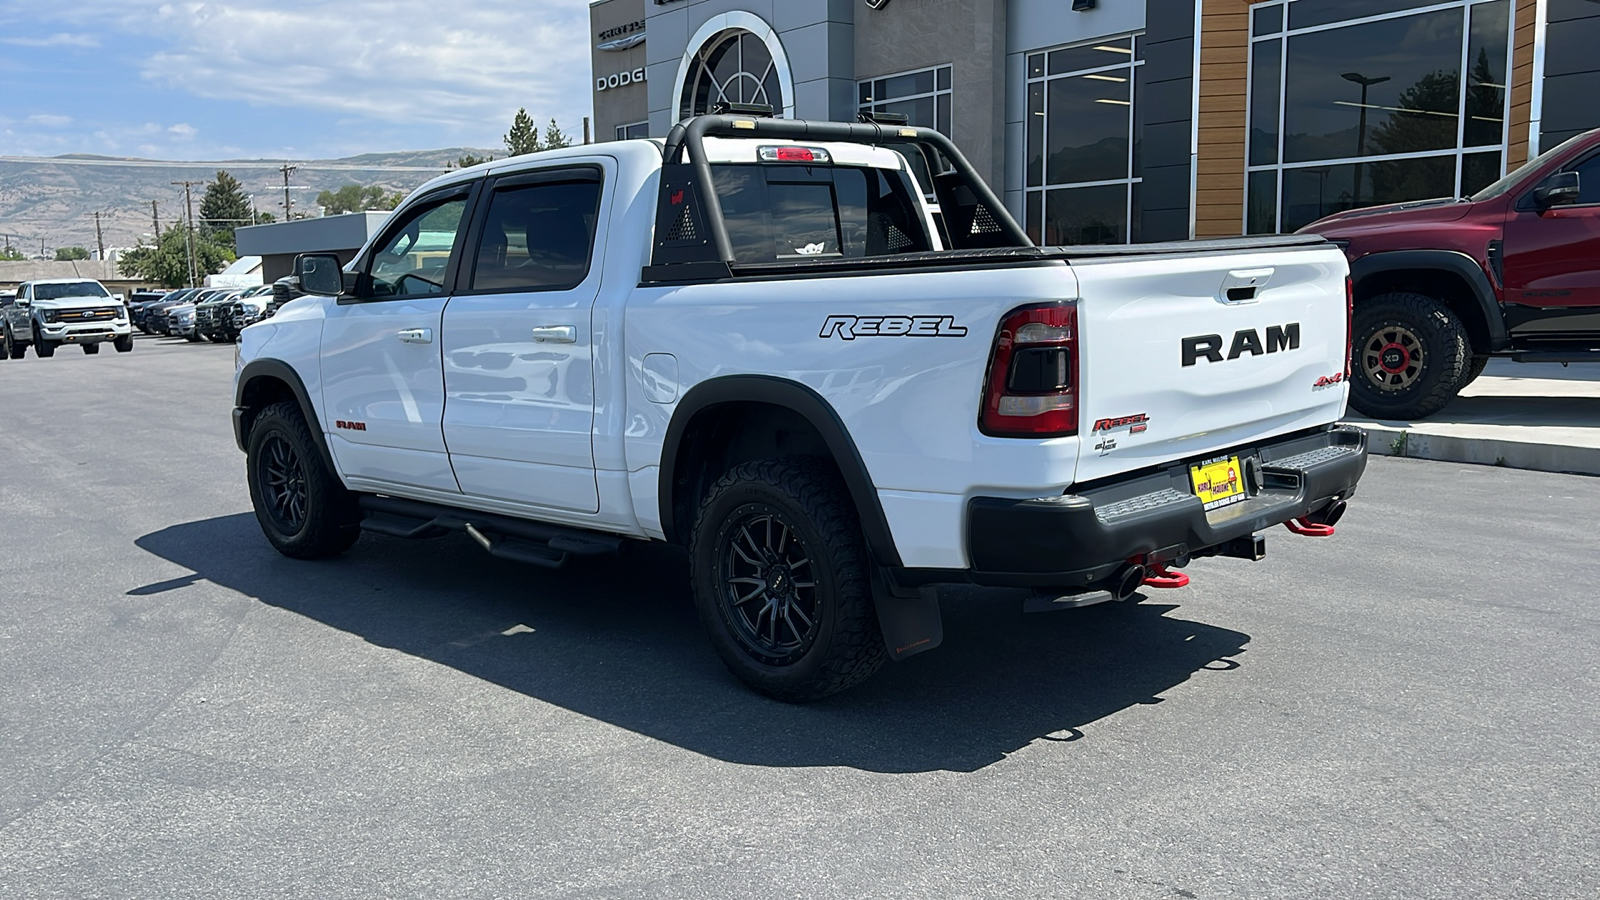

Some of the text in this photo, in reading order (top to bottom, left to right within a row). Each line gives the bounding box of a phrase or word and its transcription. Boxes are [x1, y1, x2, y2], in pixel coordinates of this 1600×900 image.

[597, 67, 647, 91] DODG
[819, 315, 968, 340] REBEL
[1181, 322, 1300, 368] RAM
[336, 420, 367, 431] RAM
[1092, 413, 1150, 432] REBEL
